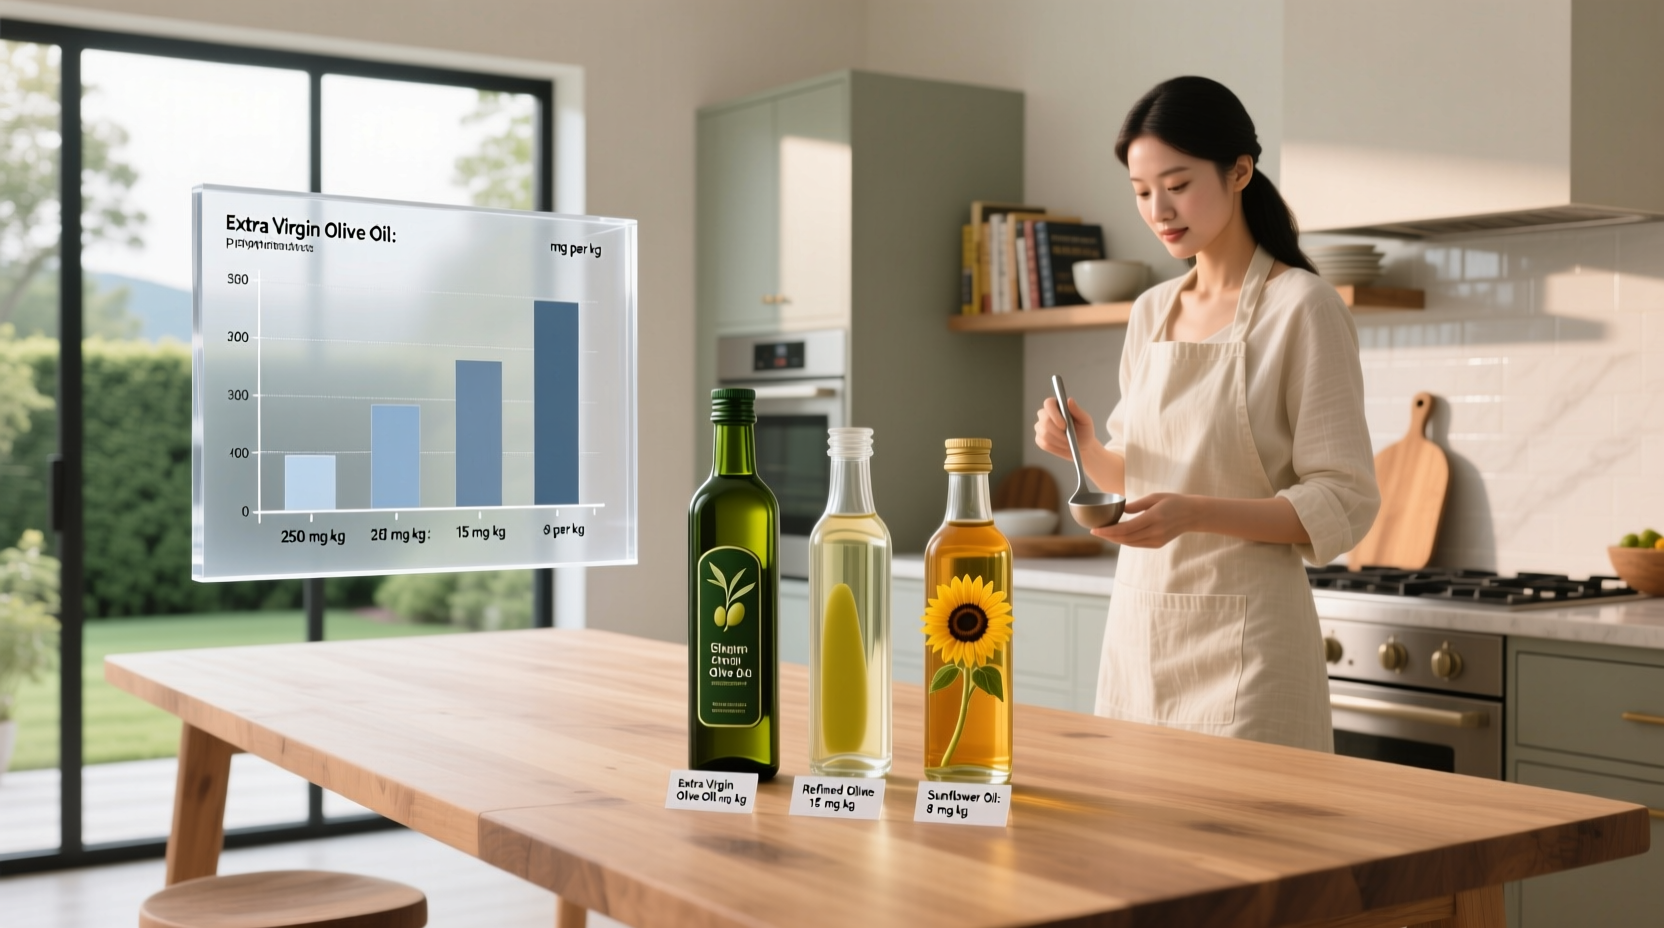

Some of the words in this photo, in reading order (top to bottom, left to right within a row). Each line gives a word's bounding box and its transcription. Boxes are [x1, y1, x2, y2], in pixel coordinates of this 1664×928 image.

[226, 214, 269, 234] Extra
[272, 216, 320, 240] Virgin
[324, 222, 366, 240] Olive
[369, 225, 396, 243] Oil:
[550, 243, 567, 256] mg
[570, 244, 588, 258] per
[227, 389, 249, 401] 300
[241, 505, 250, 517] 0
[281, 529, 306, 543] 250
[308, 532, 328, 546] mg
[330, 528, 346, 546] kg
[390, 530, 410, 543] mg
[456, 525, 470, 538] 15
[472, 528, 490, 541] mg
[492, 525, 506, 540] kg
[553, 525, 571, 538] per
[572, 522, 585, 537] kg
[678, 778, 704, 789] Extra
[927, 789, 981, 802] Sunflower
[824, 800, 840, 812] mg
[926, 803, 934, 814] 8
[937, 806, 954, 818] mg
